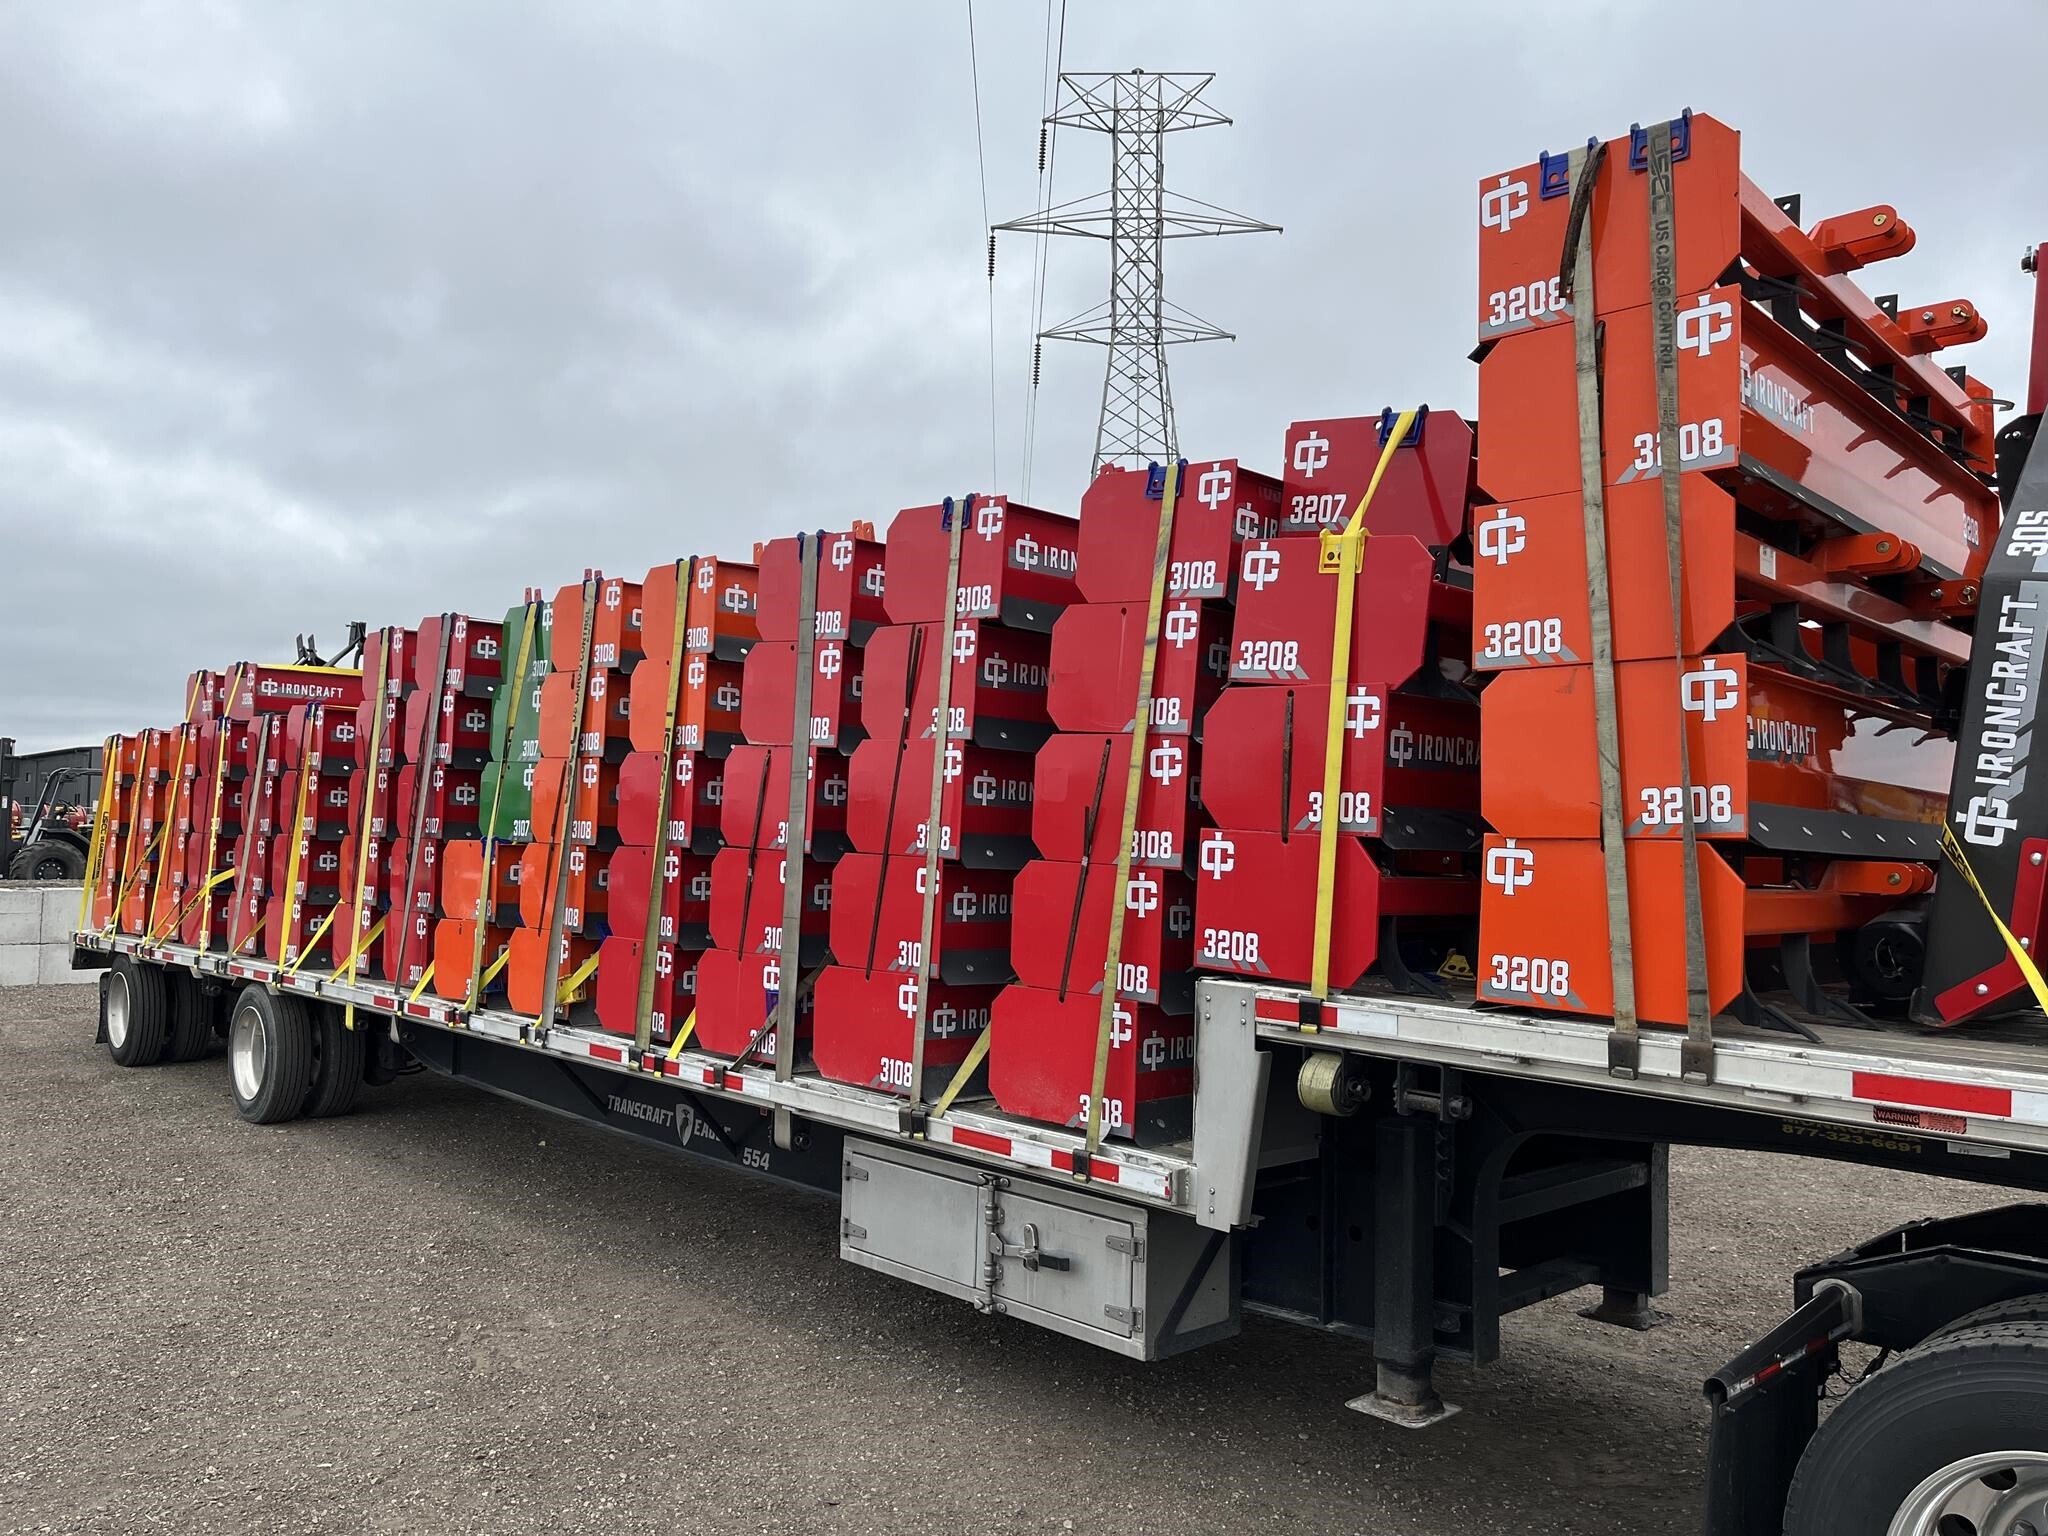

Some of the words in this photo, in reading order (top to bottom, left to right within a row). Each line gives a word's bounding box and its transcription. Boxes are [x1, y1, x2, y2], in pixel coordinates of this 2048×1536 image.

[1489, 276, 1567, 327] 3208
[1657, 300, 1675, 374] CONTROL
[1755, 370, 1814, 434] IRONCRAFT
[1633, 418, 1723, 470] 308
[1290, 494, 1346, 524] 3207
[2006, 511, 2048, 557] 305
[1170, 561, 1216, 590] 3108
[957, 585, 991, 612] 3108
[815, 611, 841, 633] 3108
[687, 627, 708, 648] 3108
[1484, 618, 1562, 658] 3208
[594, 643, 615, 663] 3108
[1239, 641, 1298, 671] 3208
[281, 683, 343, 698] IRONCRAFT
[1975, 595, 2038, 785] IRONCRAFT
[932, 708, 965, 732] 308
[1149, 697, 1180, 725] 108
[522, 740, 539, 756] 3107
[580, 732, 600, 751] 3108
[676, 725, 697, 745] 3108
[1757, 719, 1817, 756] IRONCRAFT
[1308, 792, 1370, 823] 308
[1640, 784, 1732, 825] 3208
[513, 820, 530, 836] 3107
[572, 820, 592, 839] 3108
[1130, 830, 1173, 859] 3108
[764, 927, 782, 950] 310
[1204, 928, 1259, 963] 3208
[899, 941, 921, 967] 310
[1104, 962, 1148, 994] 108
[1490, 954, 1570, 996] 3208
[880, 1057, 912, 1087] 3108
[607, 1094, 674, 1128] TRANSCRAFT
[693, 1119, 731, 1142] EAG
[1079, 1094, 1122, 1128] 308
[1877, 1110, 1919, 1123] WARNING
[1782, 1124, 1922, 1153] 877-323-6691
[742, 1147, 770, 1171] 554
